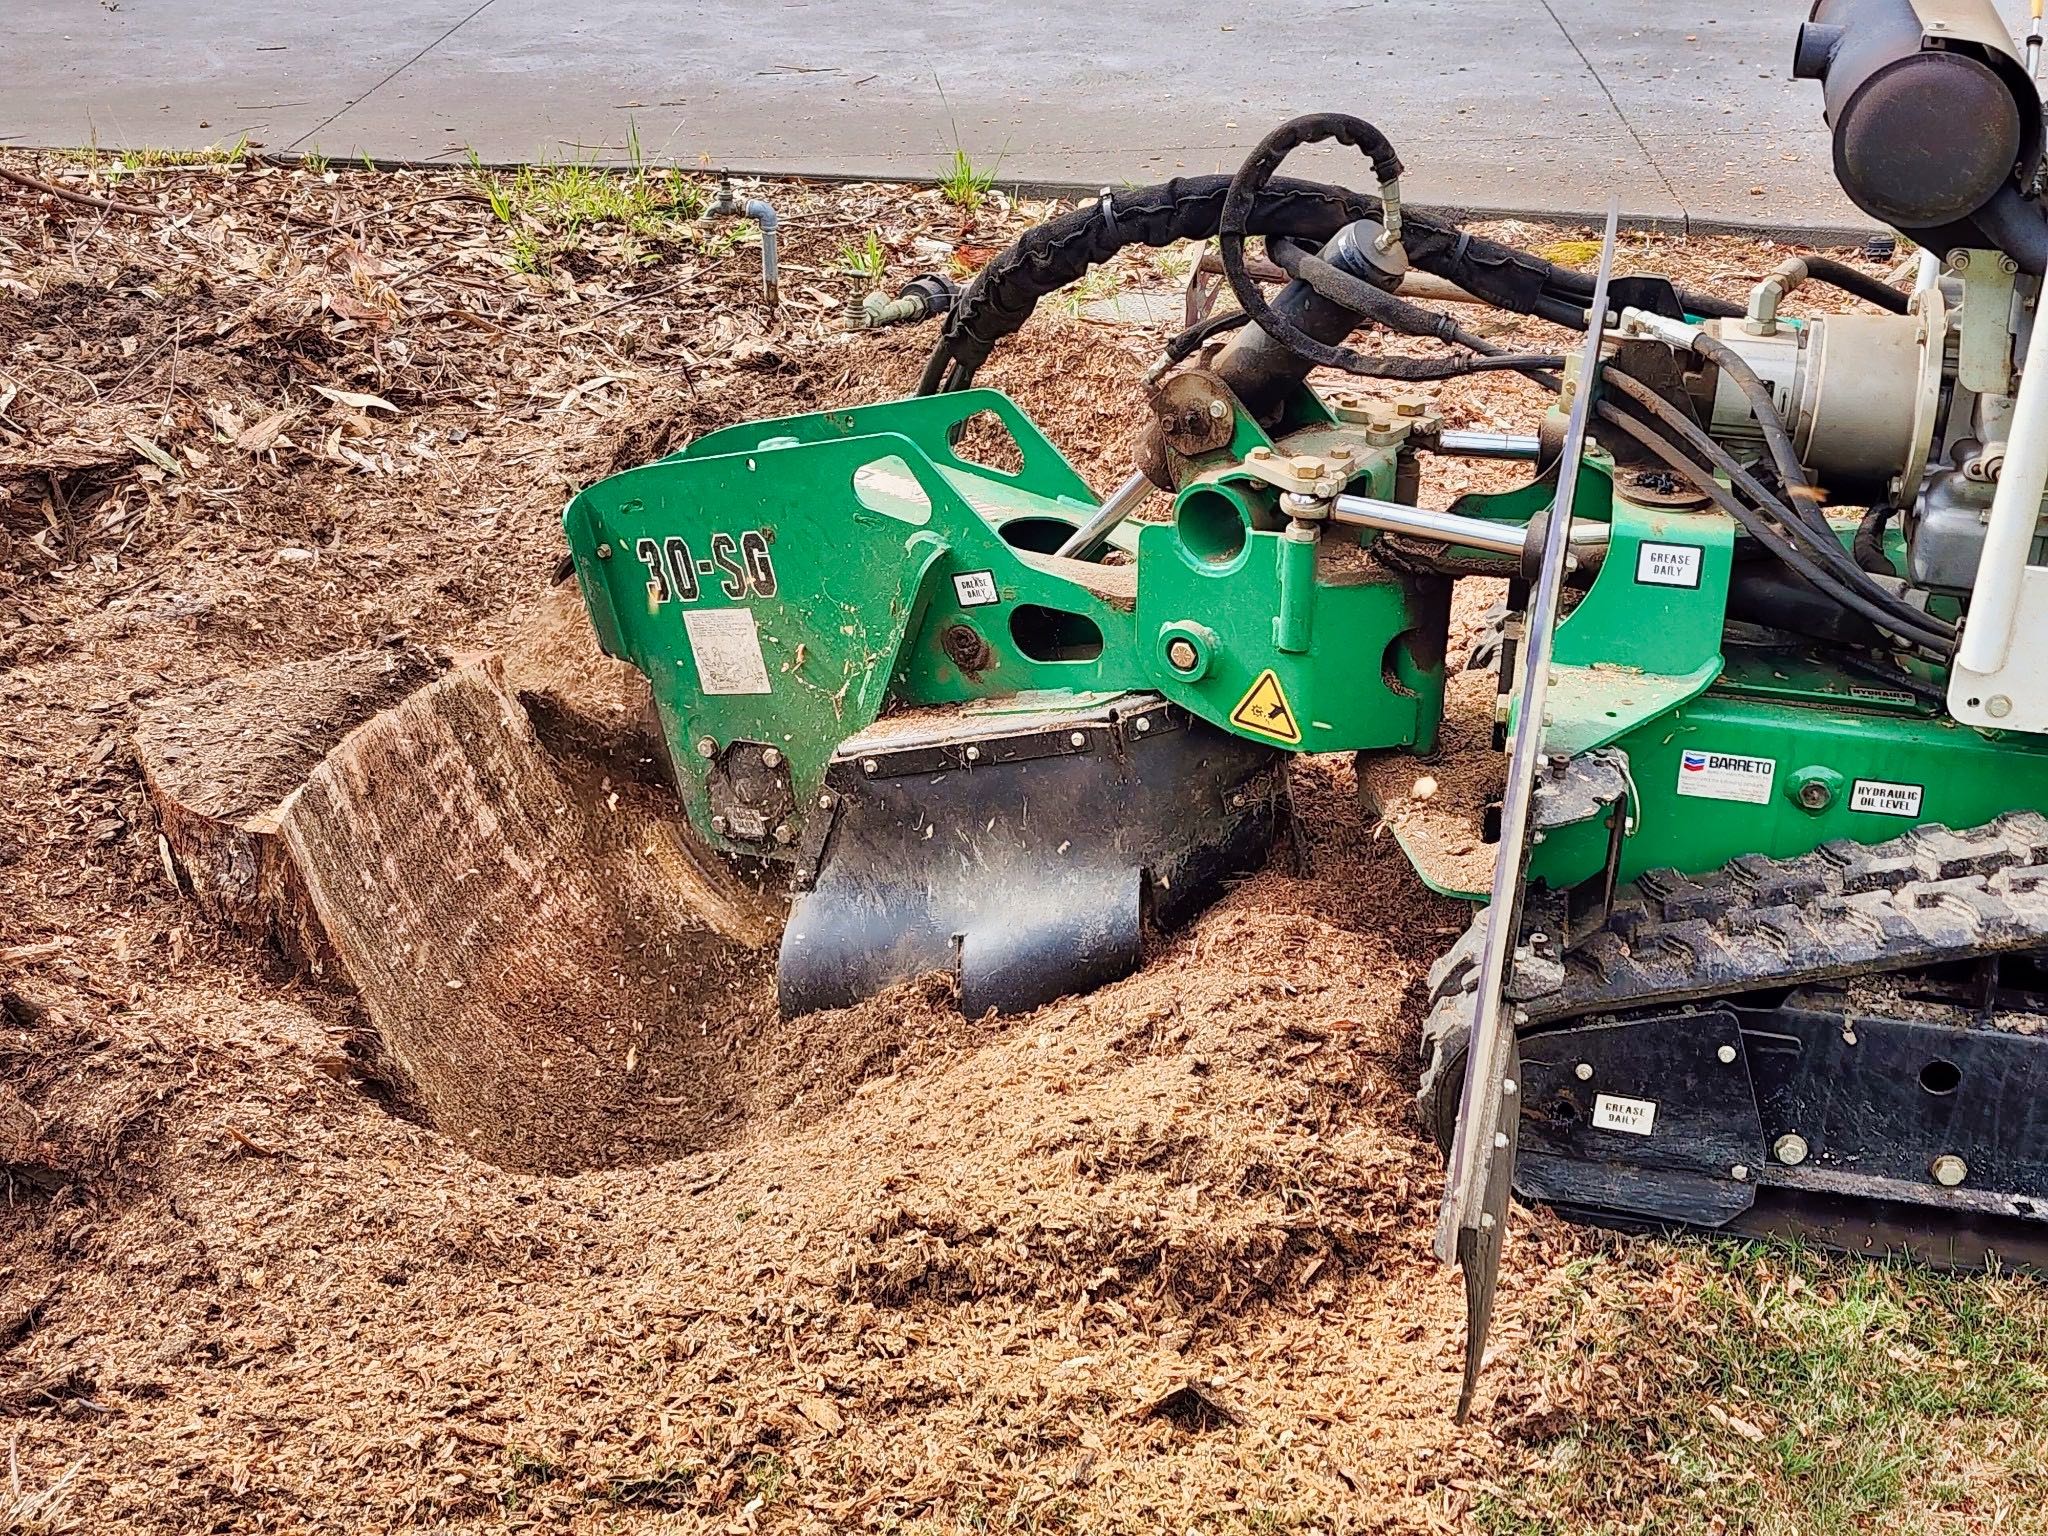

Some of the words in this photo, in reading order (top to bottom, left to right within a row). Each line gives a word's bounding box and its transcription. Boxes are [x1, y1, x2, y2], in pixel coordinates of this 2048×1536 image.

[1650, 552, 1691, 565] GREASE
[636, 531, 777, 603] 30-SG
[1653, 564, 1683, 576] DAILY
[961, 578, 988, 589] GREASE
[967, 589, 985, 598] DAILY
[1709, 756, 1772, 775] BARRETO
[1858, 786, 1918, 800] HYDRAULIC
[1860, 797, 1876, 807] OIL
[1880, 799, 1910, 811] LEVEL
[1606, 1103, 1646, 1117] GREASE
[1609, 1113, 1638, 1125] DAILY
